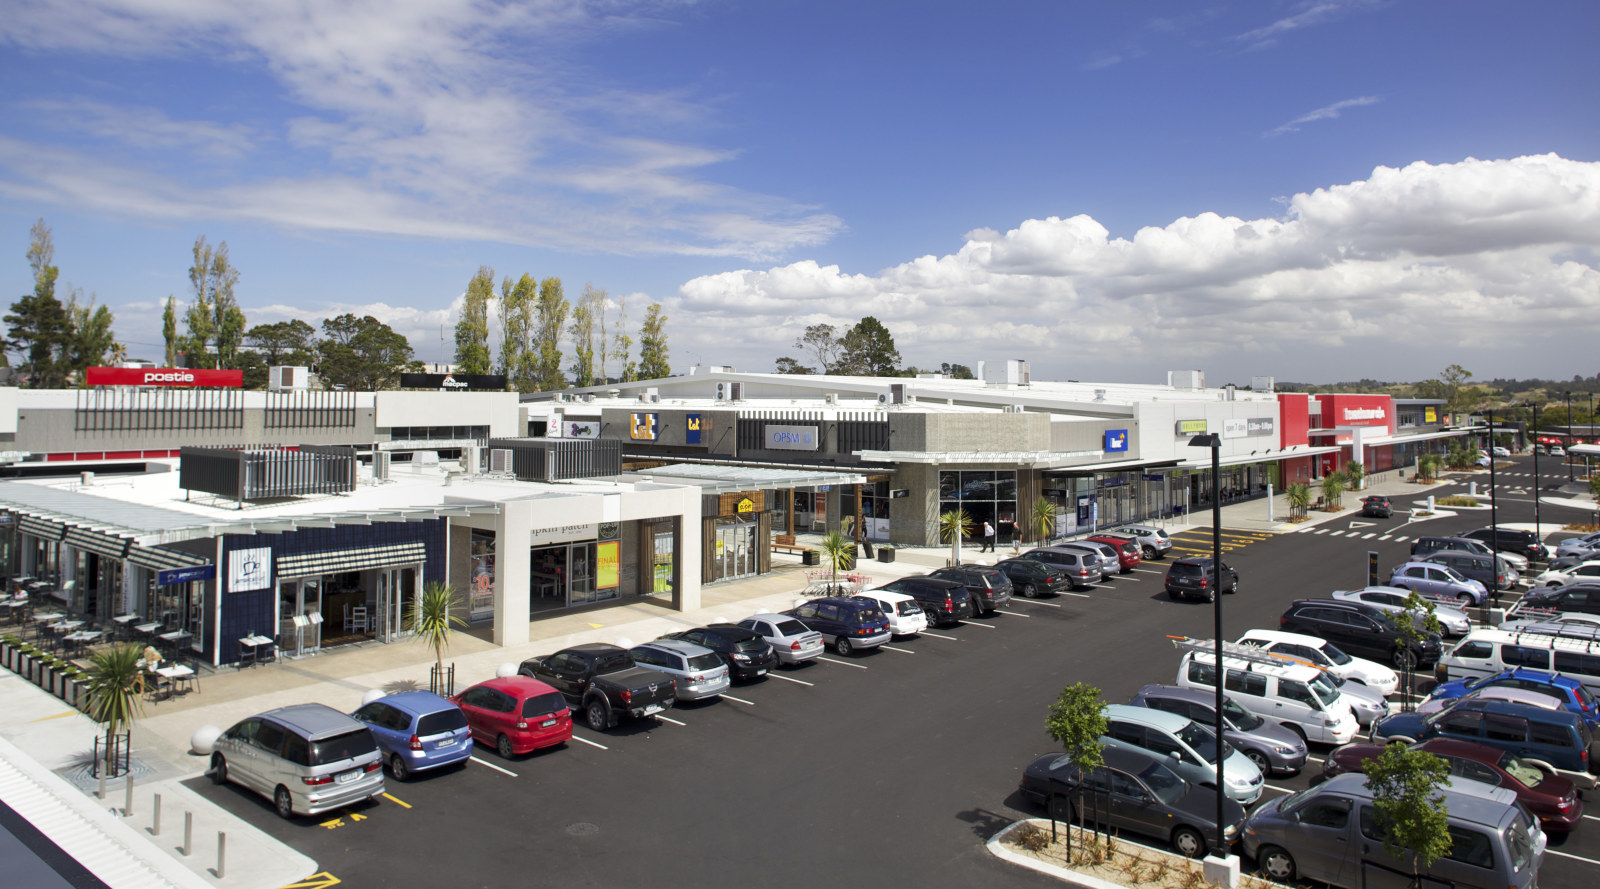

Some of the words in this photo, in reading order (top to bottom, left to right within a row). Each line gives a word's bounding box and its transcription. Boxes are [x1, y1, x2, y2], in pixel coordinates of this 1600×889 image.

[144, 371, 195, 384] postie
[630, 413, 657, 440] t&t
[773, 432, 800, 443] OPSM
[597, 556, 617, 564] FINAL
